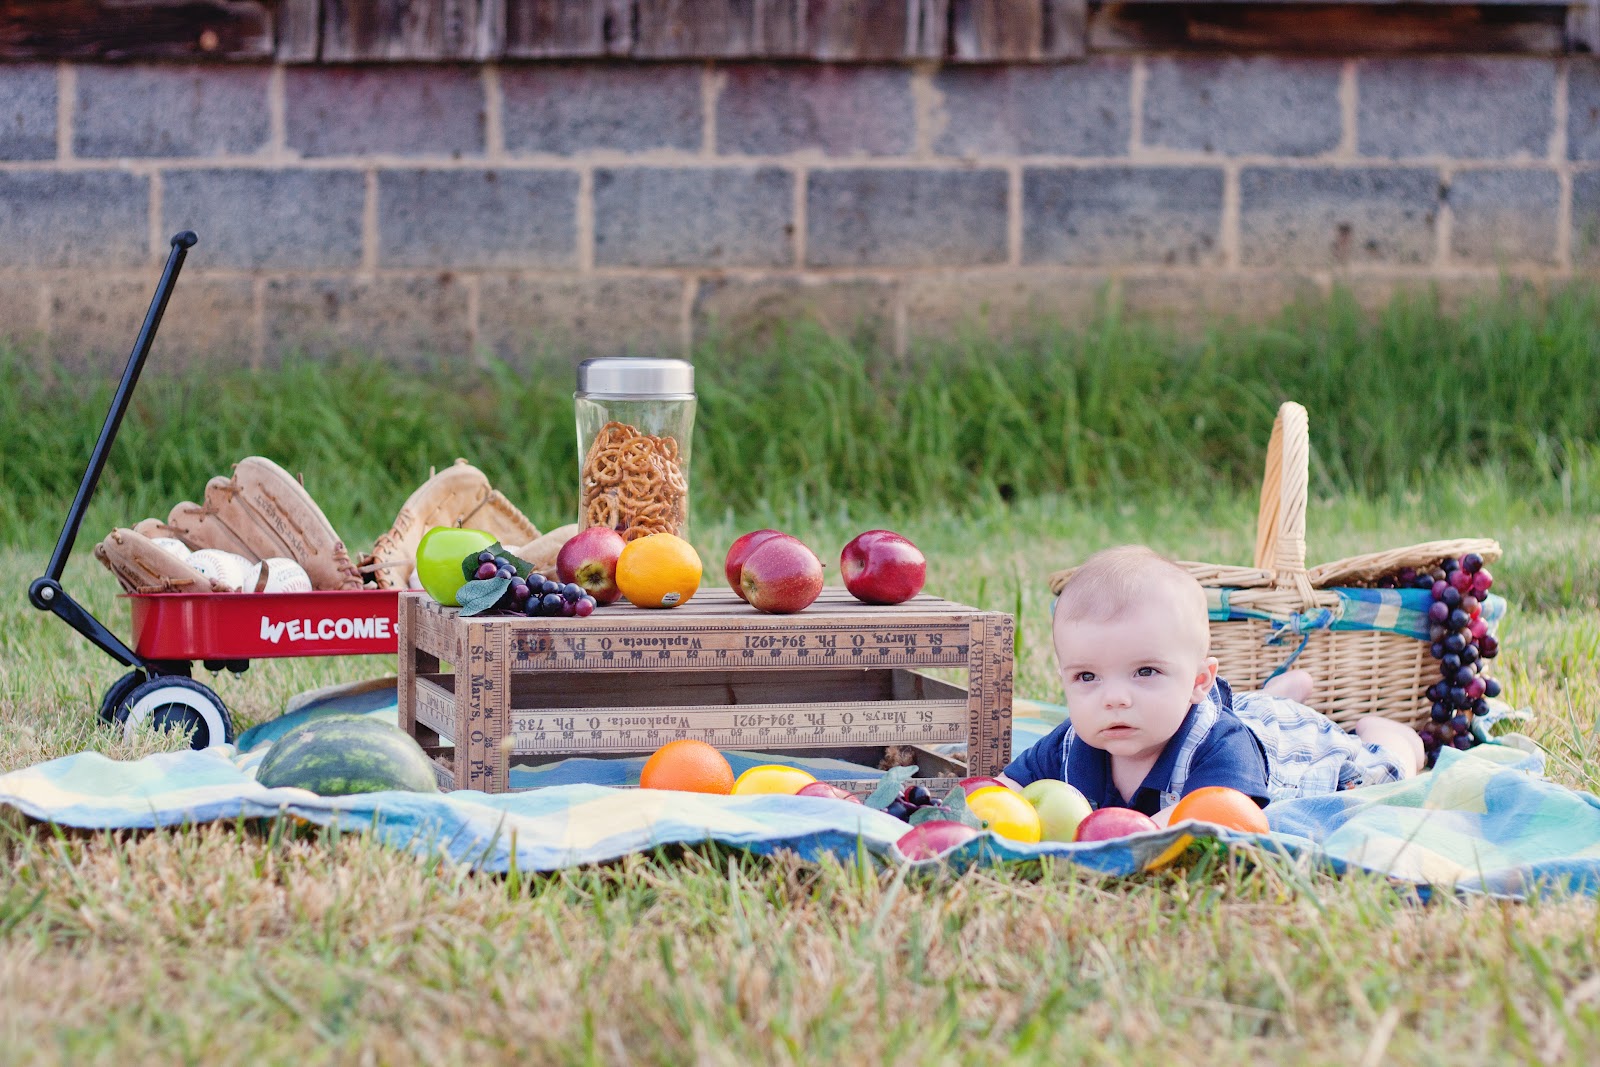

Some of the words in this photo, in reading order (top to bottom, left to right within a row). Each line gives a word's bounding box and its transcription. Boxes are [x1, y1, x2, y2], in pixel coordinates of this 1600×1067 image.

[260, 616, 391, 643] WELCOME
[563, 637, 586, 651] Ph.
[597, 637, 613, 651] O.
[619, 635, 702, 650] Wapakoneta,
[744, 635, 806, 649] 394-4921
[814, 634, 837, 648] Ph.
[848, 633, 864, 648] O.
[871, 632, 917, 647] Marys,
[925, 633, 943, 646] St.
[1002, 614, 1014, 662] 738-39
[471, 645, 484, 664] St.
[970, 637, 984, 698] BARRY
[470, 673, 485, 721] Marys,
[552, 717, 575, 731] Ph.
[585, 717, 600, 731] O.
[607, 715, 690, 729] Wapakoneta,
[732, 714, 795, 727] 394-4921
[803, 712, 826, 726] Ph.
[839, 711, 855, 725] O.
[862, 711, 908, 724] Marys,
[915, 711, 934, 723] St.
[471, 730, 484, 746] O.
[471, 759, 484, 782] Ph.
